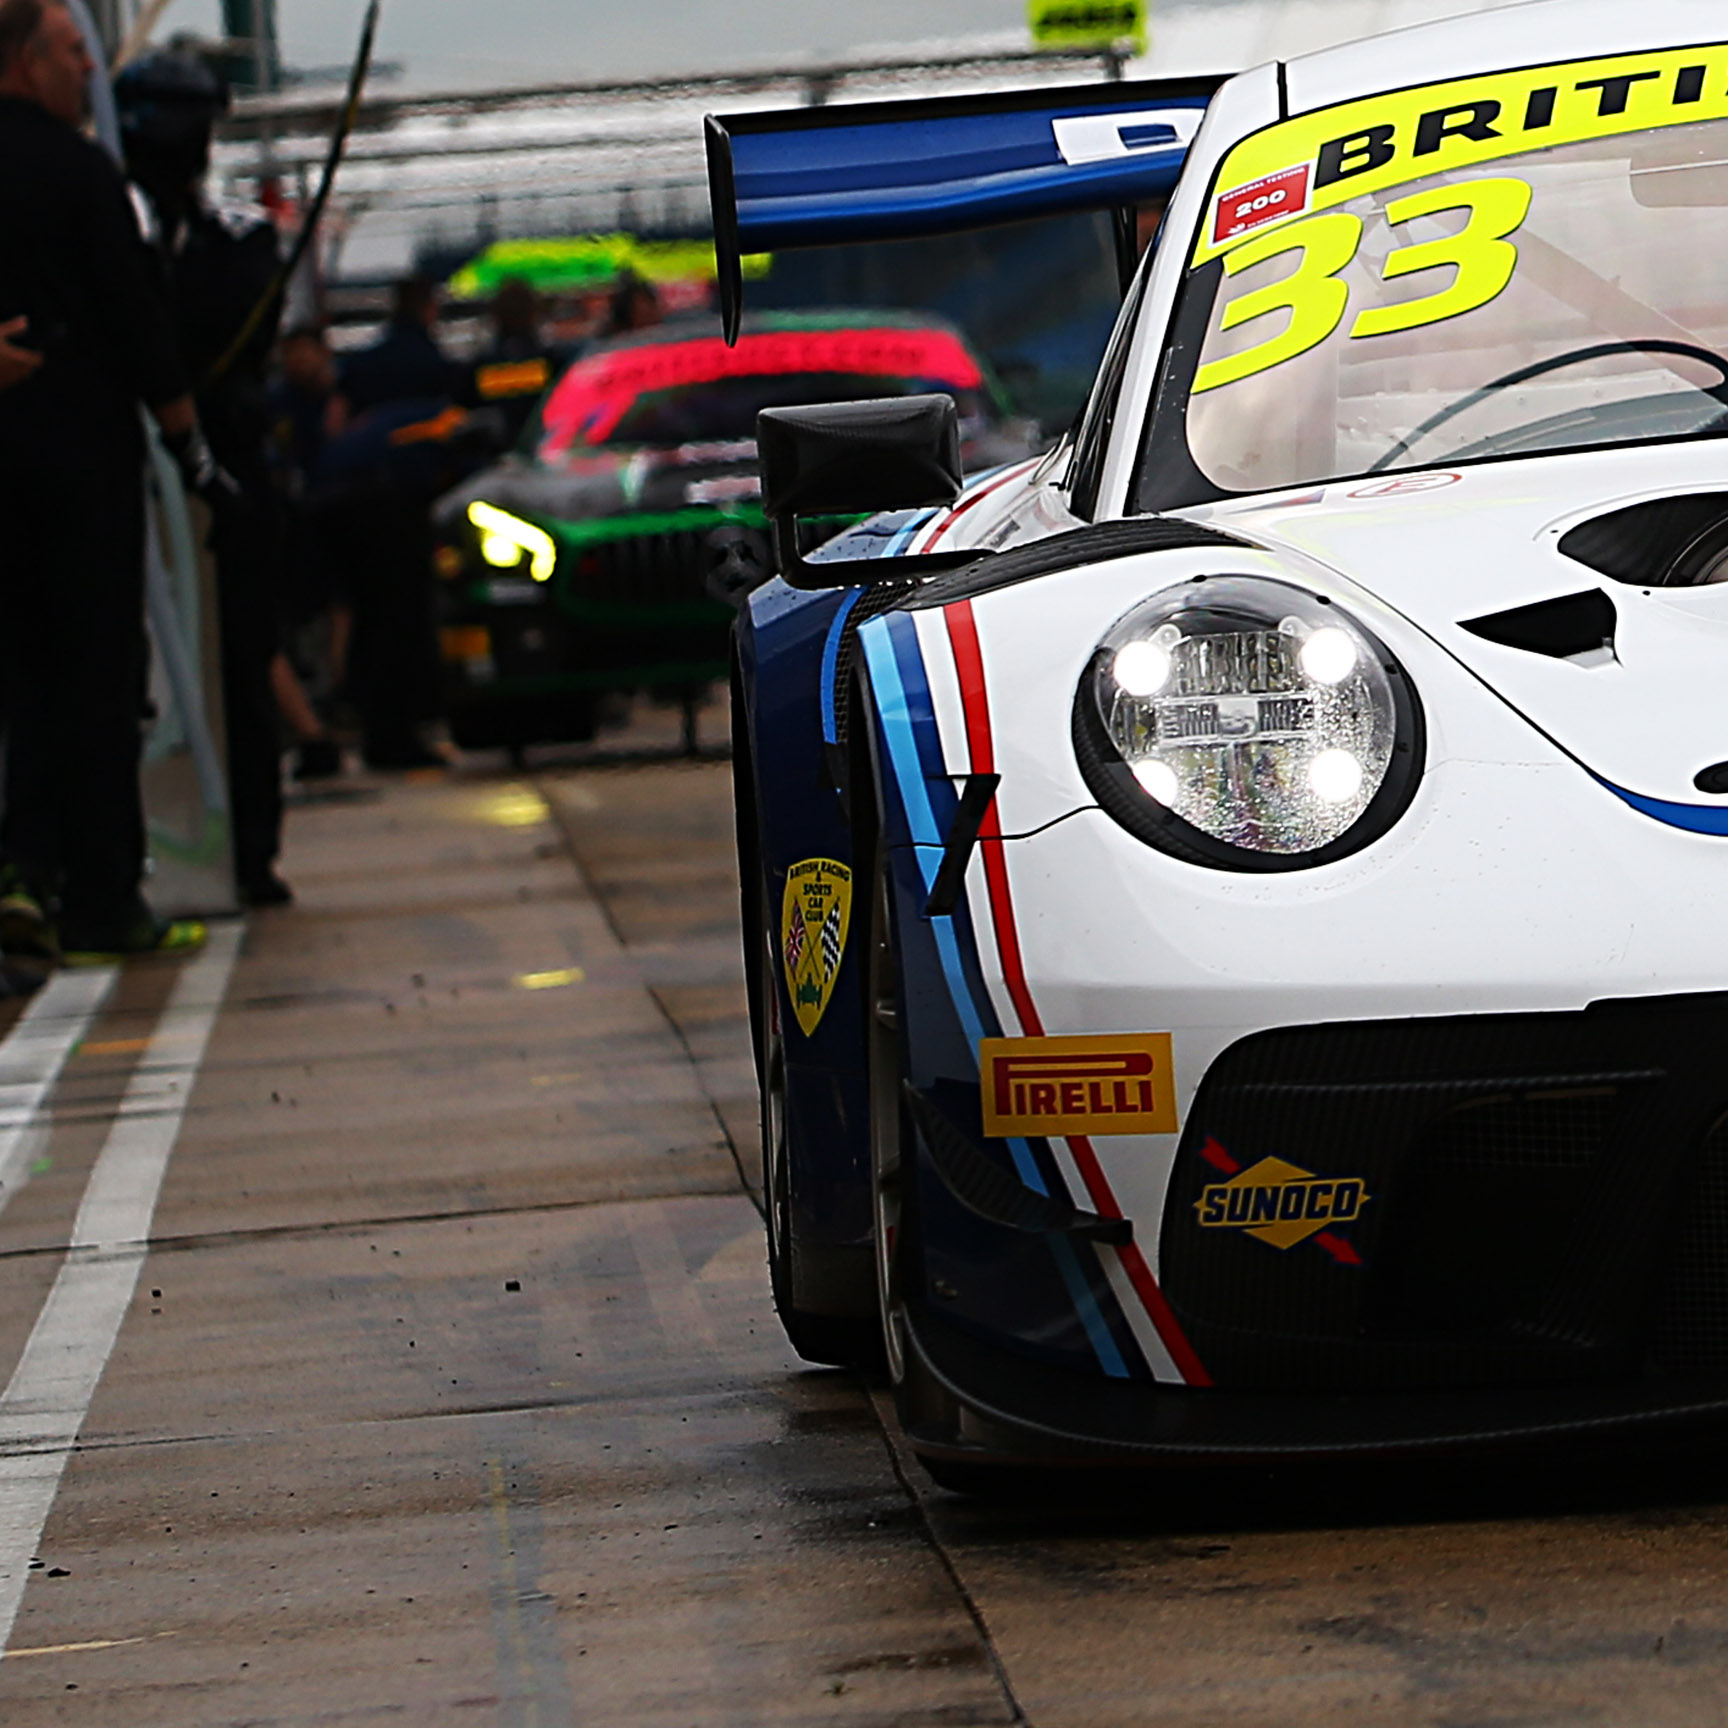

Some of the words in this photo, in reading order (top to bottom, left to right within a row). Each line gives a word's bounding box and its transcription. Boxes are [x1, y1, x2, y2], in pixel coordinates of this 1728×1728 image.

[1234, 189, 1287, 218] 200
[1191, 177, 1532, 394] 33
[992, 1052, 1154, 1116] PIRELLI
[1202, 1181, 1361, 1223] SUNOCO
